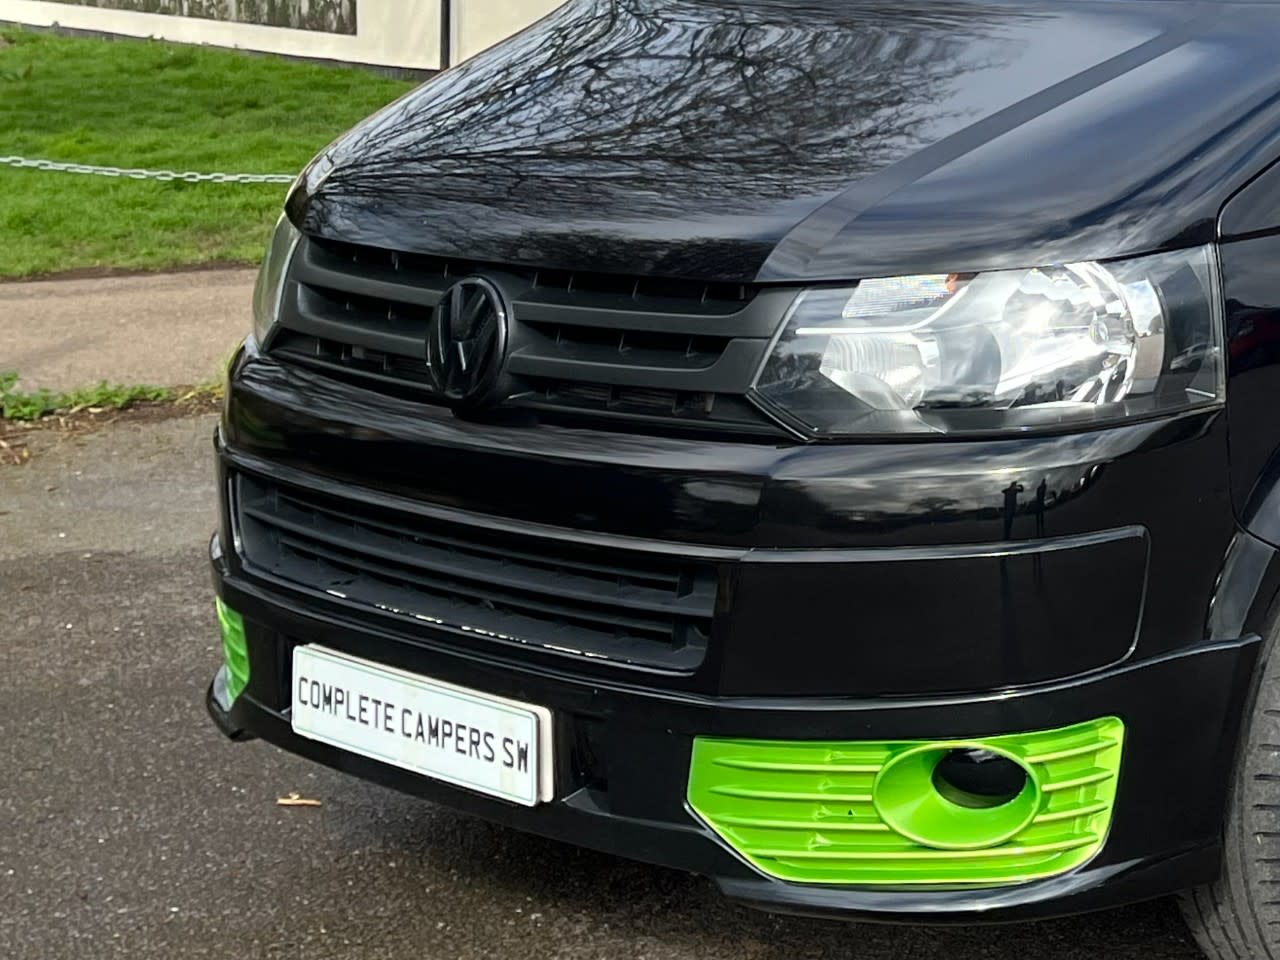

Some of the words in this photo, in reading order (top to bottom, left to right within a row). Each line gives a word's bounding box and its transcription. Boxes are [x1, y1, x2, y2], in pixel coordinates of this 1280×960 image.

[298, 676, 395, 733] COMPLETE
[400, 708, 496, 763] CAMPERS
[502, 737, 529, 773] SW
